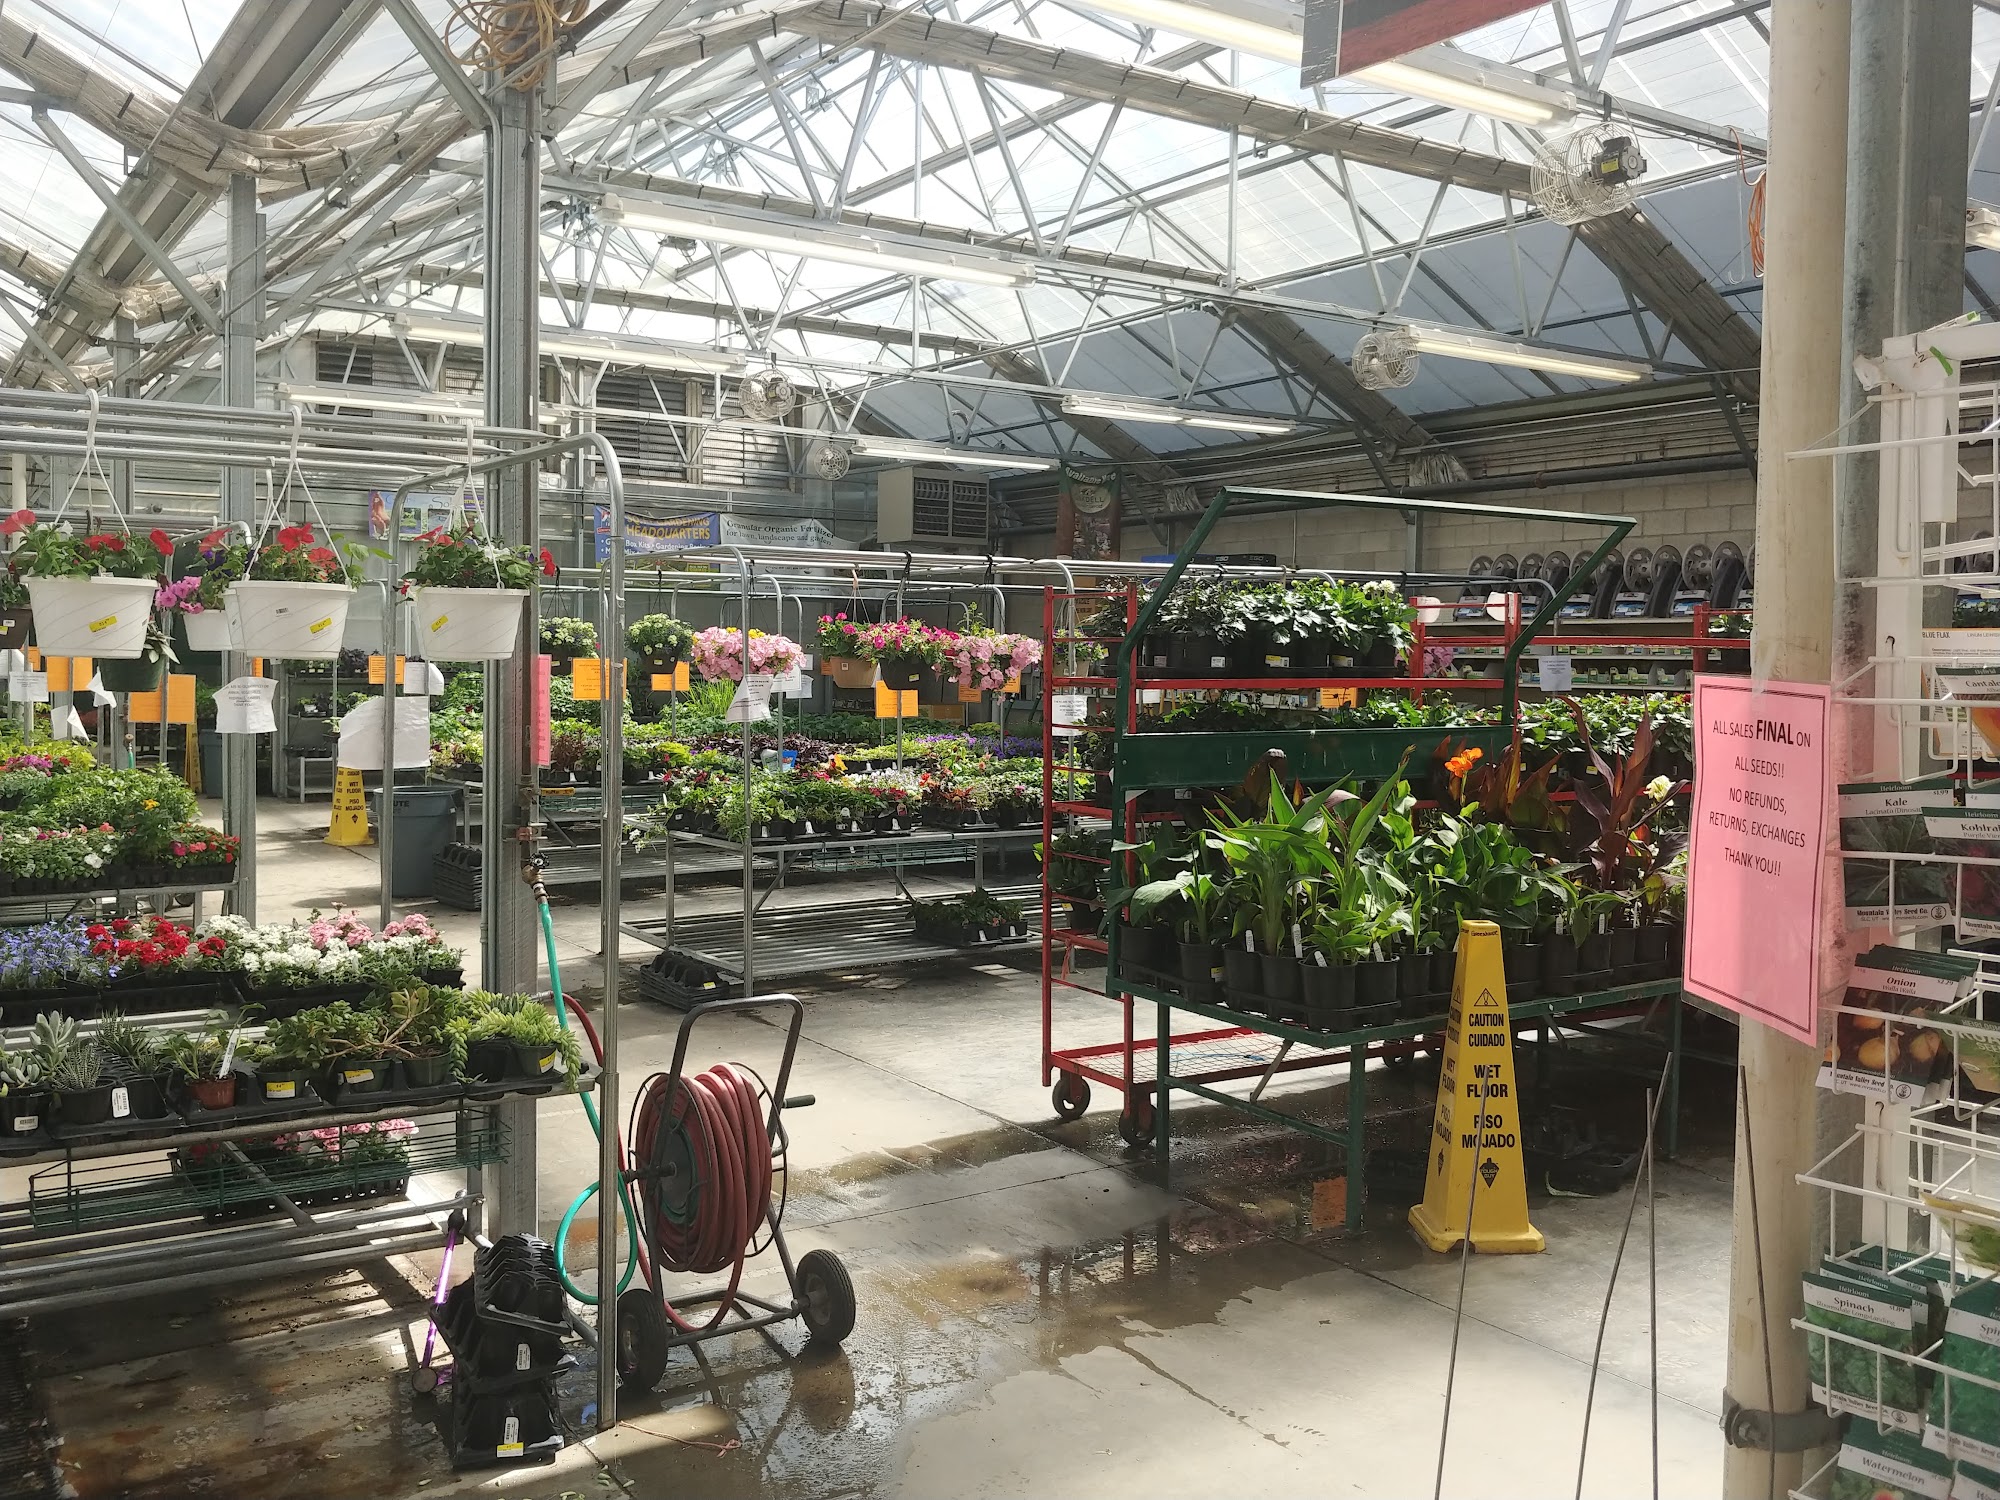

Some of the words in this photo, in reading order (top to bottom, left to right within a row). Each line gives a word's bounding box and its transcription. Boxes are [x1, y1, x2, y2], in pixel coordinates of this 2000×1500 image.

[626, 525, 711, 540] HEADQUARTERS
[726, 519, 762, 533] Granular
[763, 525, 798, 534] Organic
[800, 524, 835, 539] Fertilizer
[726, 529, 738, 538] for
[739, 530, 758, 541] lawn,
[758, 533, 796, 543] landscape
[625, 540, 637, 548] Box
[638, 540, 651, 549] Kits
[1922, 631, 1936, 639] BLUE
[1937, 631, 1950, 639] FLAX
[1713, 720, 1727, 734] ALL
[1730, 722, 1754, 739] SALES
[1756, 719, 1794, 745] FINAL
[1796, 732, 1811, 748] ON
[1734, 756, 1749, 772] ALL
[1751, 758, 1785, 779] SEEDS!!
[1729, 787, 1742, 803] NO
[1744, 790, 1787, 816] REFUNDS,
[1885, 797, 1908, 807] Kale
[1865, 808, 1894, 816] Lacinata
[1964, 811, 1999, 819] Heirloom
[1709, 811, 1749, 836] RETURNS,
[1751, 821, 1806, 848] EXCHANGES
[1724, 847, 1752, 869] THANK
[1755, 856, 1781, 877] YOU!!
[1856, 909, 1885, 917] Mountain
[1891, 965, 1921, 975] Heirloom
[1886, 976, 1917, 988] Onion
[1882, 984, 1899, 993] Walla
[1899, 987, 1917, 995] Walla
[1468, 1013, 1504, 1027] CAUTION
[1468, 1033, 1505, 1047] CUIDADO
[1473, 1064, 1501, 1079] WET
[1855, 1075, 1870, 1085] Valley
[1871, 1079, 1886, 1088] Seed
[1466, 1083, 1508, 1098] FLOOR
[1858, 1274, 1889, 1290] Heirloom
[1838, 1285, 1870, 1298] Heirloom
[1834, 1297, 1875, 1314] Spinach
[1862, 1457, 1925, 1485] Watermelon
